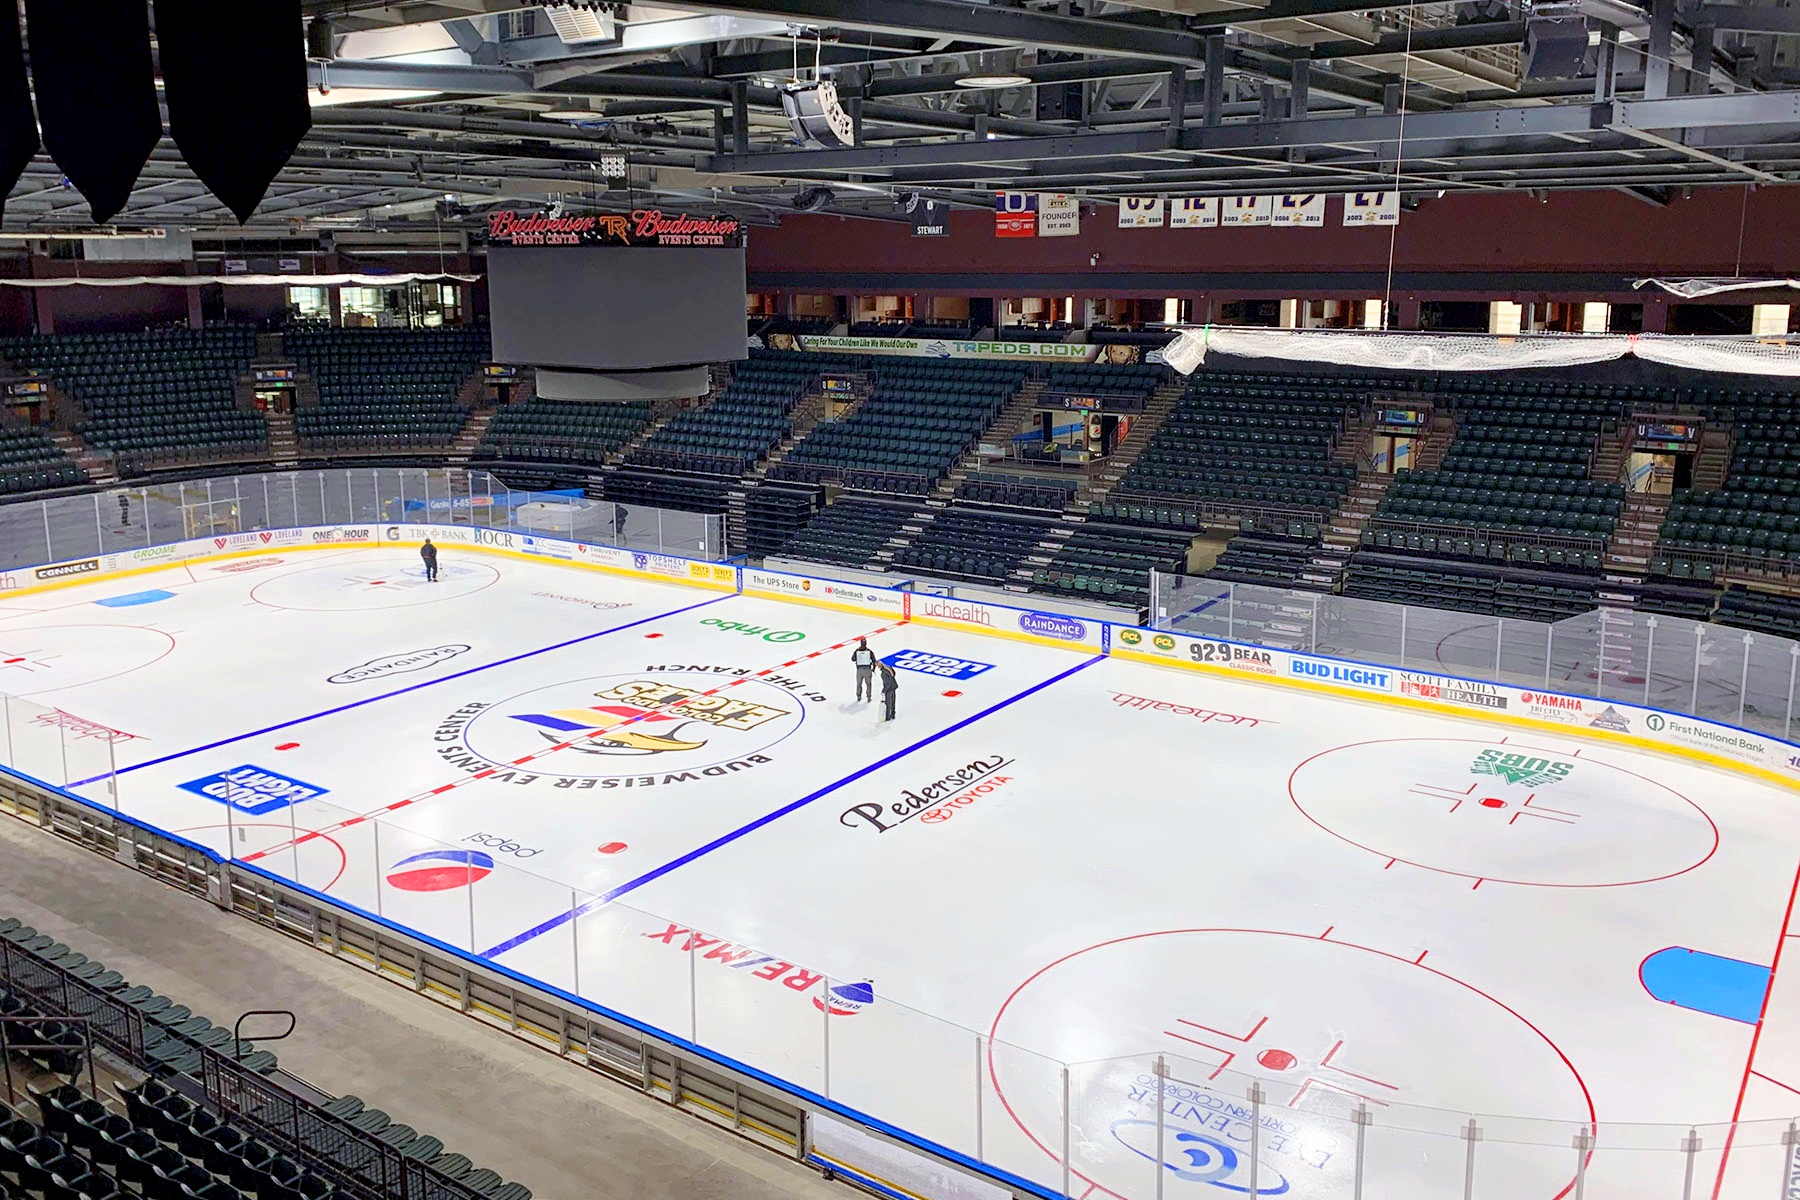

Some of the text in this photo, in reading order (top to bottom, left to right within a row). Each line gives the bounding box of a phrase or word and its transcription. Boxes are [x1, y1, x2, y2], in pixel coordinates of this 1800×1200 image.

[488, 210, 596, 237] Budweiser
[632, 210, 738, 237] Budweiser
[1042, 212, 1077, 221] FOUNDER
[917, 226, 943, 235] STEWART
[512, 234, 580, 245] EVENTS CENTER
[659, 234, 724, 245] EVENTS CENTER
[804, 336, 819, 348] Caring
[827, 338, 839, 347] Your
[839, 338, 859, 348] Children
[860, 339, 870, 348] Like
[879, 340, 896, 349] Would
[906, 341, 918, 350] Own
[953, 340, 1087, 357] TRPEDS.COM
[1638, 424, 1696, 439] U V
[229, 533, 257, 545] LOVELAND
[275, 529, 303, 540] LOVELAND
[313, 529, 370, 540] ONE HOUR
[410, 527, 468, 541] TBK BANK
[483, 531, 514, 548] OCR
[133, 545, 177, 560] GROOME
[647, 554, 686, 566] TOPSHELF
[38, 561, 96, 579] CONNELL
[655, 562, 680, 570] PRINTERS
[753, 575, 799, 590] The UPS Store
[835, 588, 863, 599] Dellenbach
[925, 600, 990, 625] uchealth
[700, 618, 770, 635] fnbo
[1122, 631, 1140, 642] PCL
[1155, 637, 1173, 647] PCL
[1190, 643, 1231, 662] 92.9
[1234, 648, 1271, 667] BEAR
[646, 665, 751, 676] RANCH
[894, 660, 963, 676] BUD
[895, 651, 988, 673] LIGHT
[1229, 662, 1255, 672] CLASSIC
[1292, 660, 1388, 687] BUD LIGHT
[764, 675, 806, 691] THE
[1400, 672, 1500, 696] SCOTT FAMILY
[594, 681, 791, 731] EAGLES
[1447, 688, 1500, 707] HEALTH
[1534, 694, 1582, 711] YAMAHA
[1113, 693, 1259, 727] uchealth
[434, 702, 773, 788] BUDWEISER EVENTS CENTER
[1670, 721, 1765, 754] First National Bank
[1477, 749, 1574, 776] SUBS
[219, 769, 318, 801] LIGHT
[943, 776, 1013, 809] TOYOTA
[202, 781, 277, 808] BUD
[839, 755, 1004, 834] Pedersen
[461, 832, 544, 858] pepsi
[647, 924, 823, 992] RE/MAX
[1127, 1084, 1333, 1169] EE CENTER
